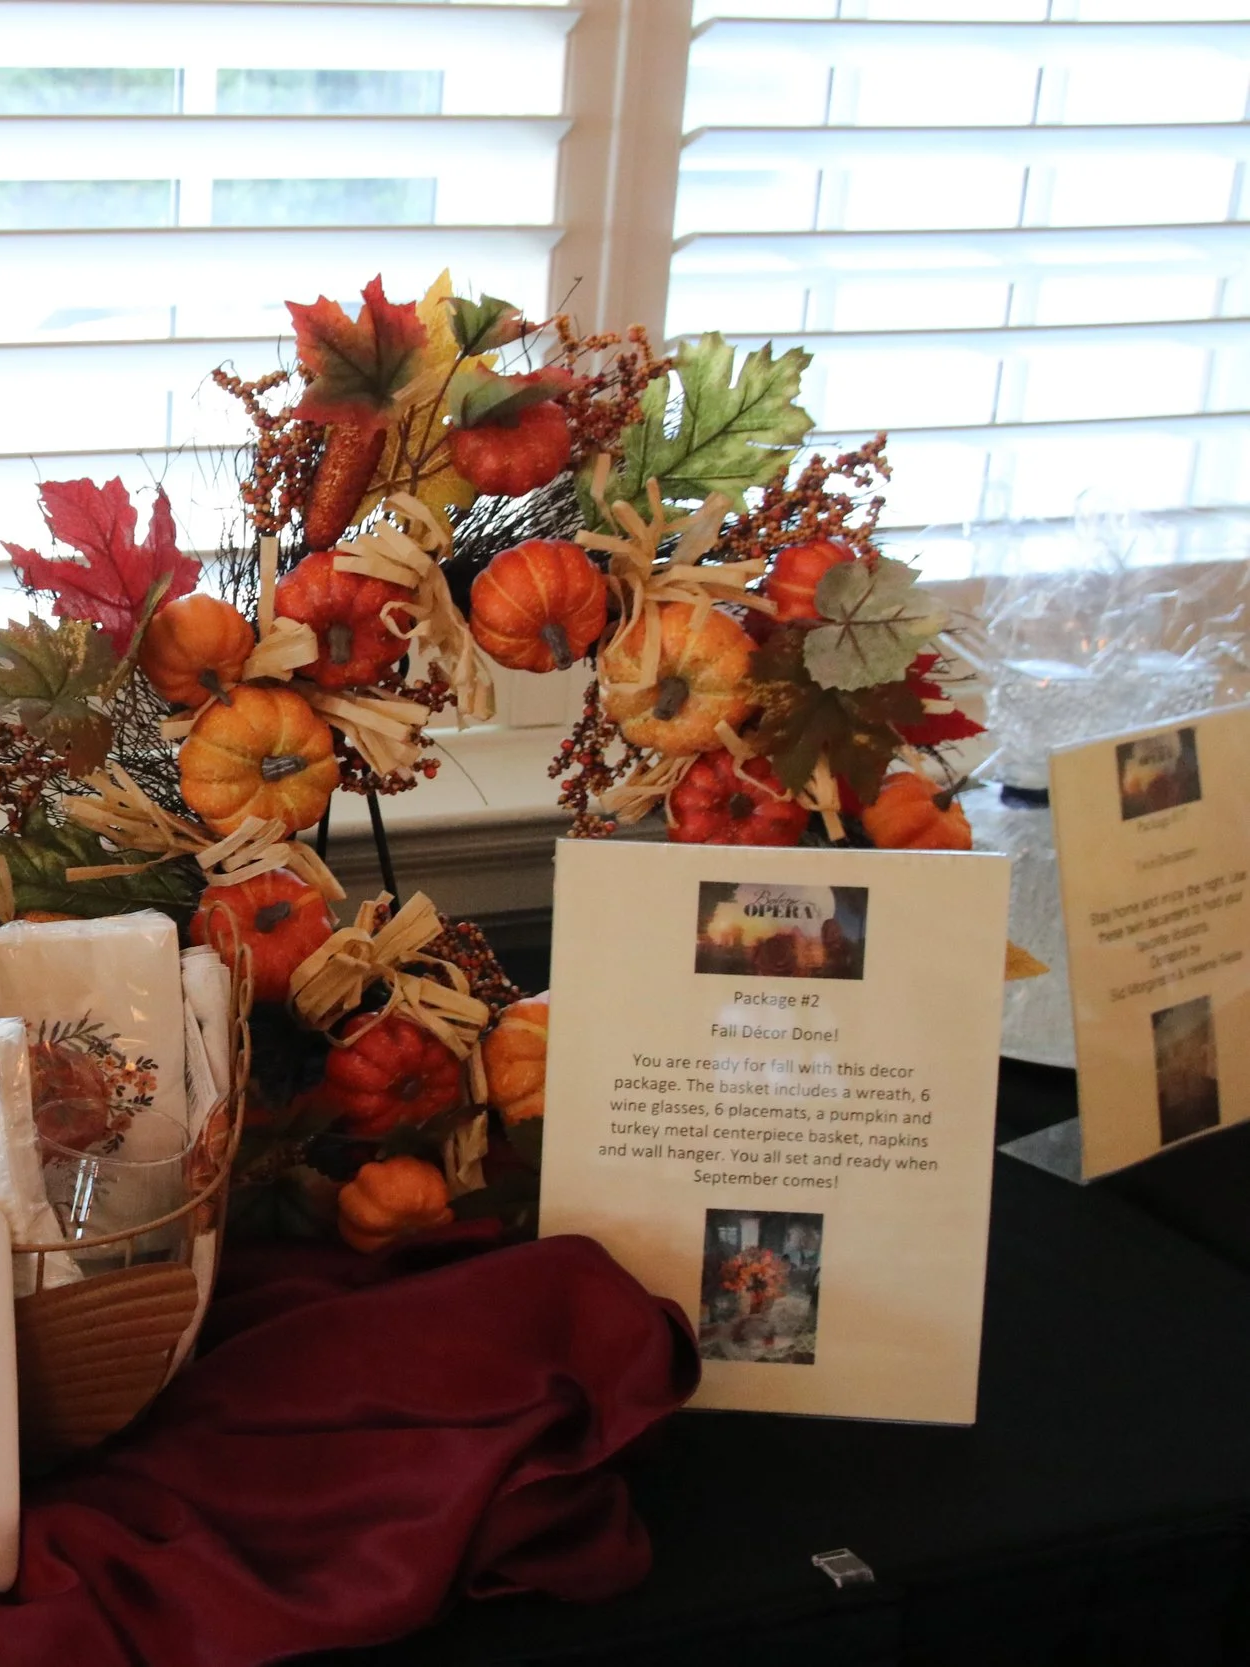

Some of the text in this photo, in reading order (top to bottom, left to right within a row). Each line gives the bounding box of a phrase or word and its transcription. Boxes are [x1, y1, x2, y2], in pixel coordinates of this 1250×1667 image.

[744, 903, 814, 920] OPERA
[733, 991, 820, 1009] Package #2
[711, 1023, 839, 1042] Fall Décor Done!
[633, 1053, 915, 1078] You are ready for fall with this decor
[614, 1076, 931, 1103] package. The basket includes a wreath, 6
[610, 1098, 932, 1125] wine glasses, 6 placemats, a pumpkin and
[611, 1121, 929, 1149] turkey metal centerpiece basket, napkins
[599, 1143, 939, 1172] and wall hanger. You all set and ready when
[693, 1169, 839, 1189] September comes!
